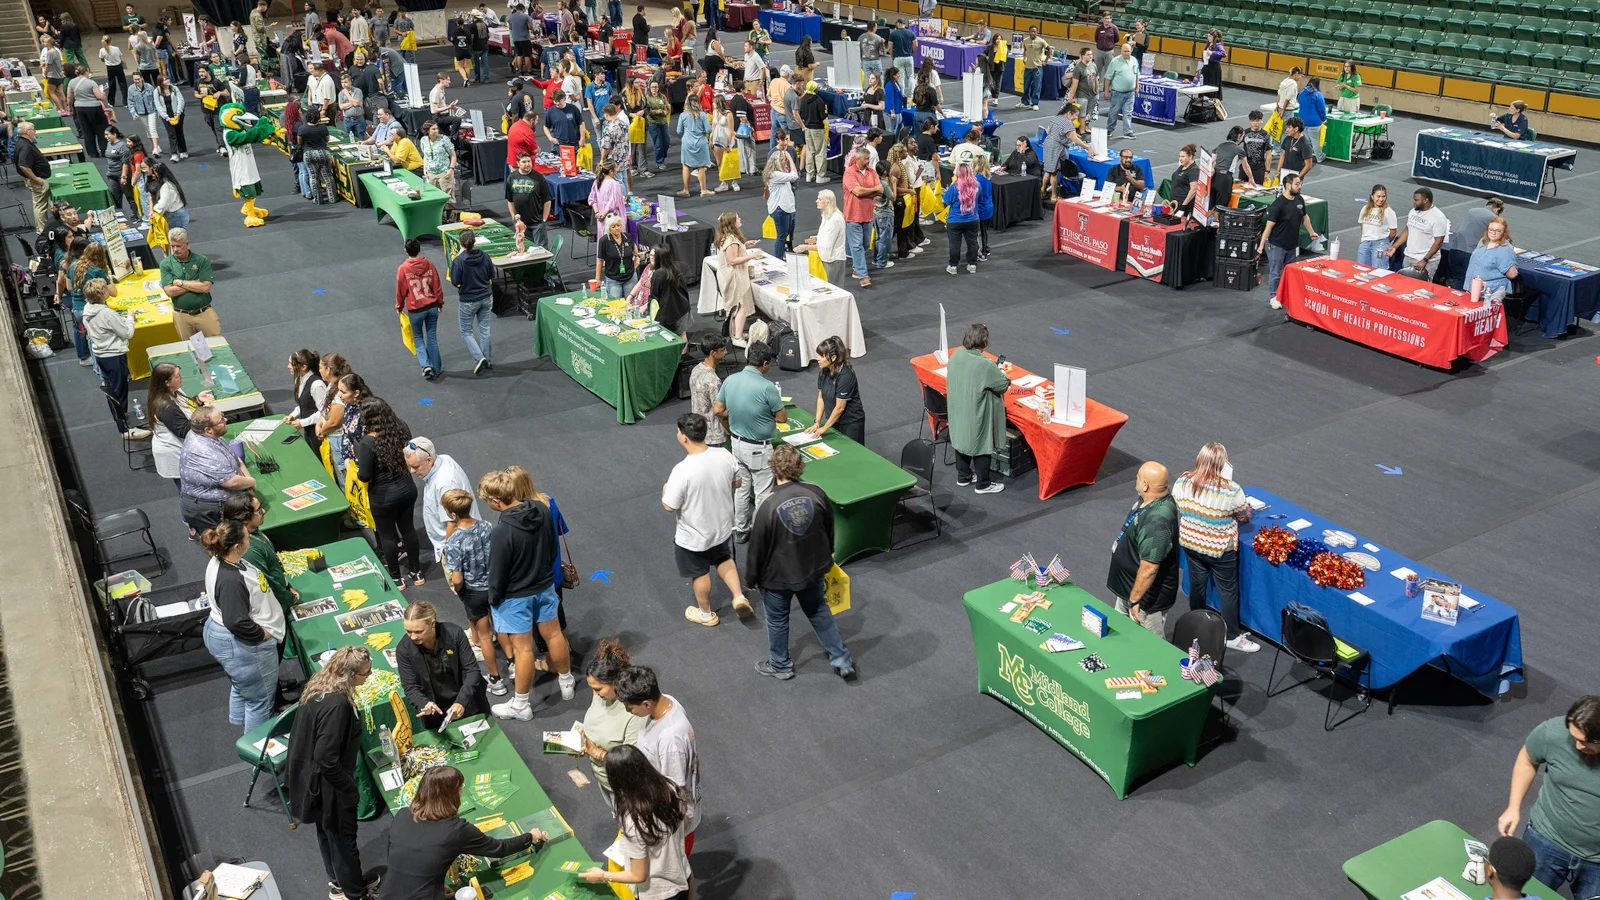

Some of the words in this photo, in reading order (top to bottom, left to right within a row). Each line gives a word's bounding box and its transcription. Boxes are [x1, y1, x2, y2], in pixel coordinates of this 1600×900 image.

[920, 44, 944, 60] UMHB
[1420, 150, 1441, 169] hsc
[1459, 164, 1484, 172] UNIVERSITY
[1061, 227, 1082, 241] TUHSC
[1083, 236, 1091, 246] EL
[1092, 239, 1108, 250] PASO
[1305, 284, 1319, 294] TEXAS
[1331, 293, 1358, 306] UNIVERSITY
[1369, 306, 1387, 316] HEALTH
[1388, 312, 1409, 323] SCIENCES
[1409, 319, 1428, 329] CENTER
[1304, 298, 1329, 316] SCHOOL
[1332, 308, 1341, 319] OF
[1344, 312, 1371, 330] HEALTH
[1374, 322, 1425, 347] PROFESSIONS
[1474, 313, 1502, 337] HEALTH
[568, 335, 584, 351] Information
[584, 346, 605, 364] Management
[580, 336, 601, 353] Management
[782, 498, 806, 511] POLICE
[1030, 664, 1090, 722] Midland
[1036, 686, 1090, 739] College
[988, 686, 1010, 705] Veteran
[1011, 700, 1024, 713] and
[1024, 707, 1047, 730] Military
[1048, 726, 1079, 754] Affiliation
[1080, 750, 1110, 781] Outreach
